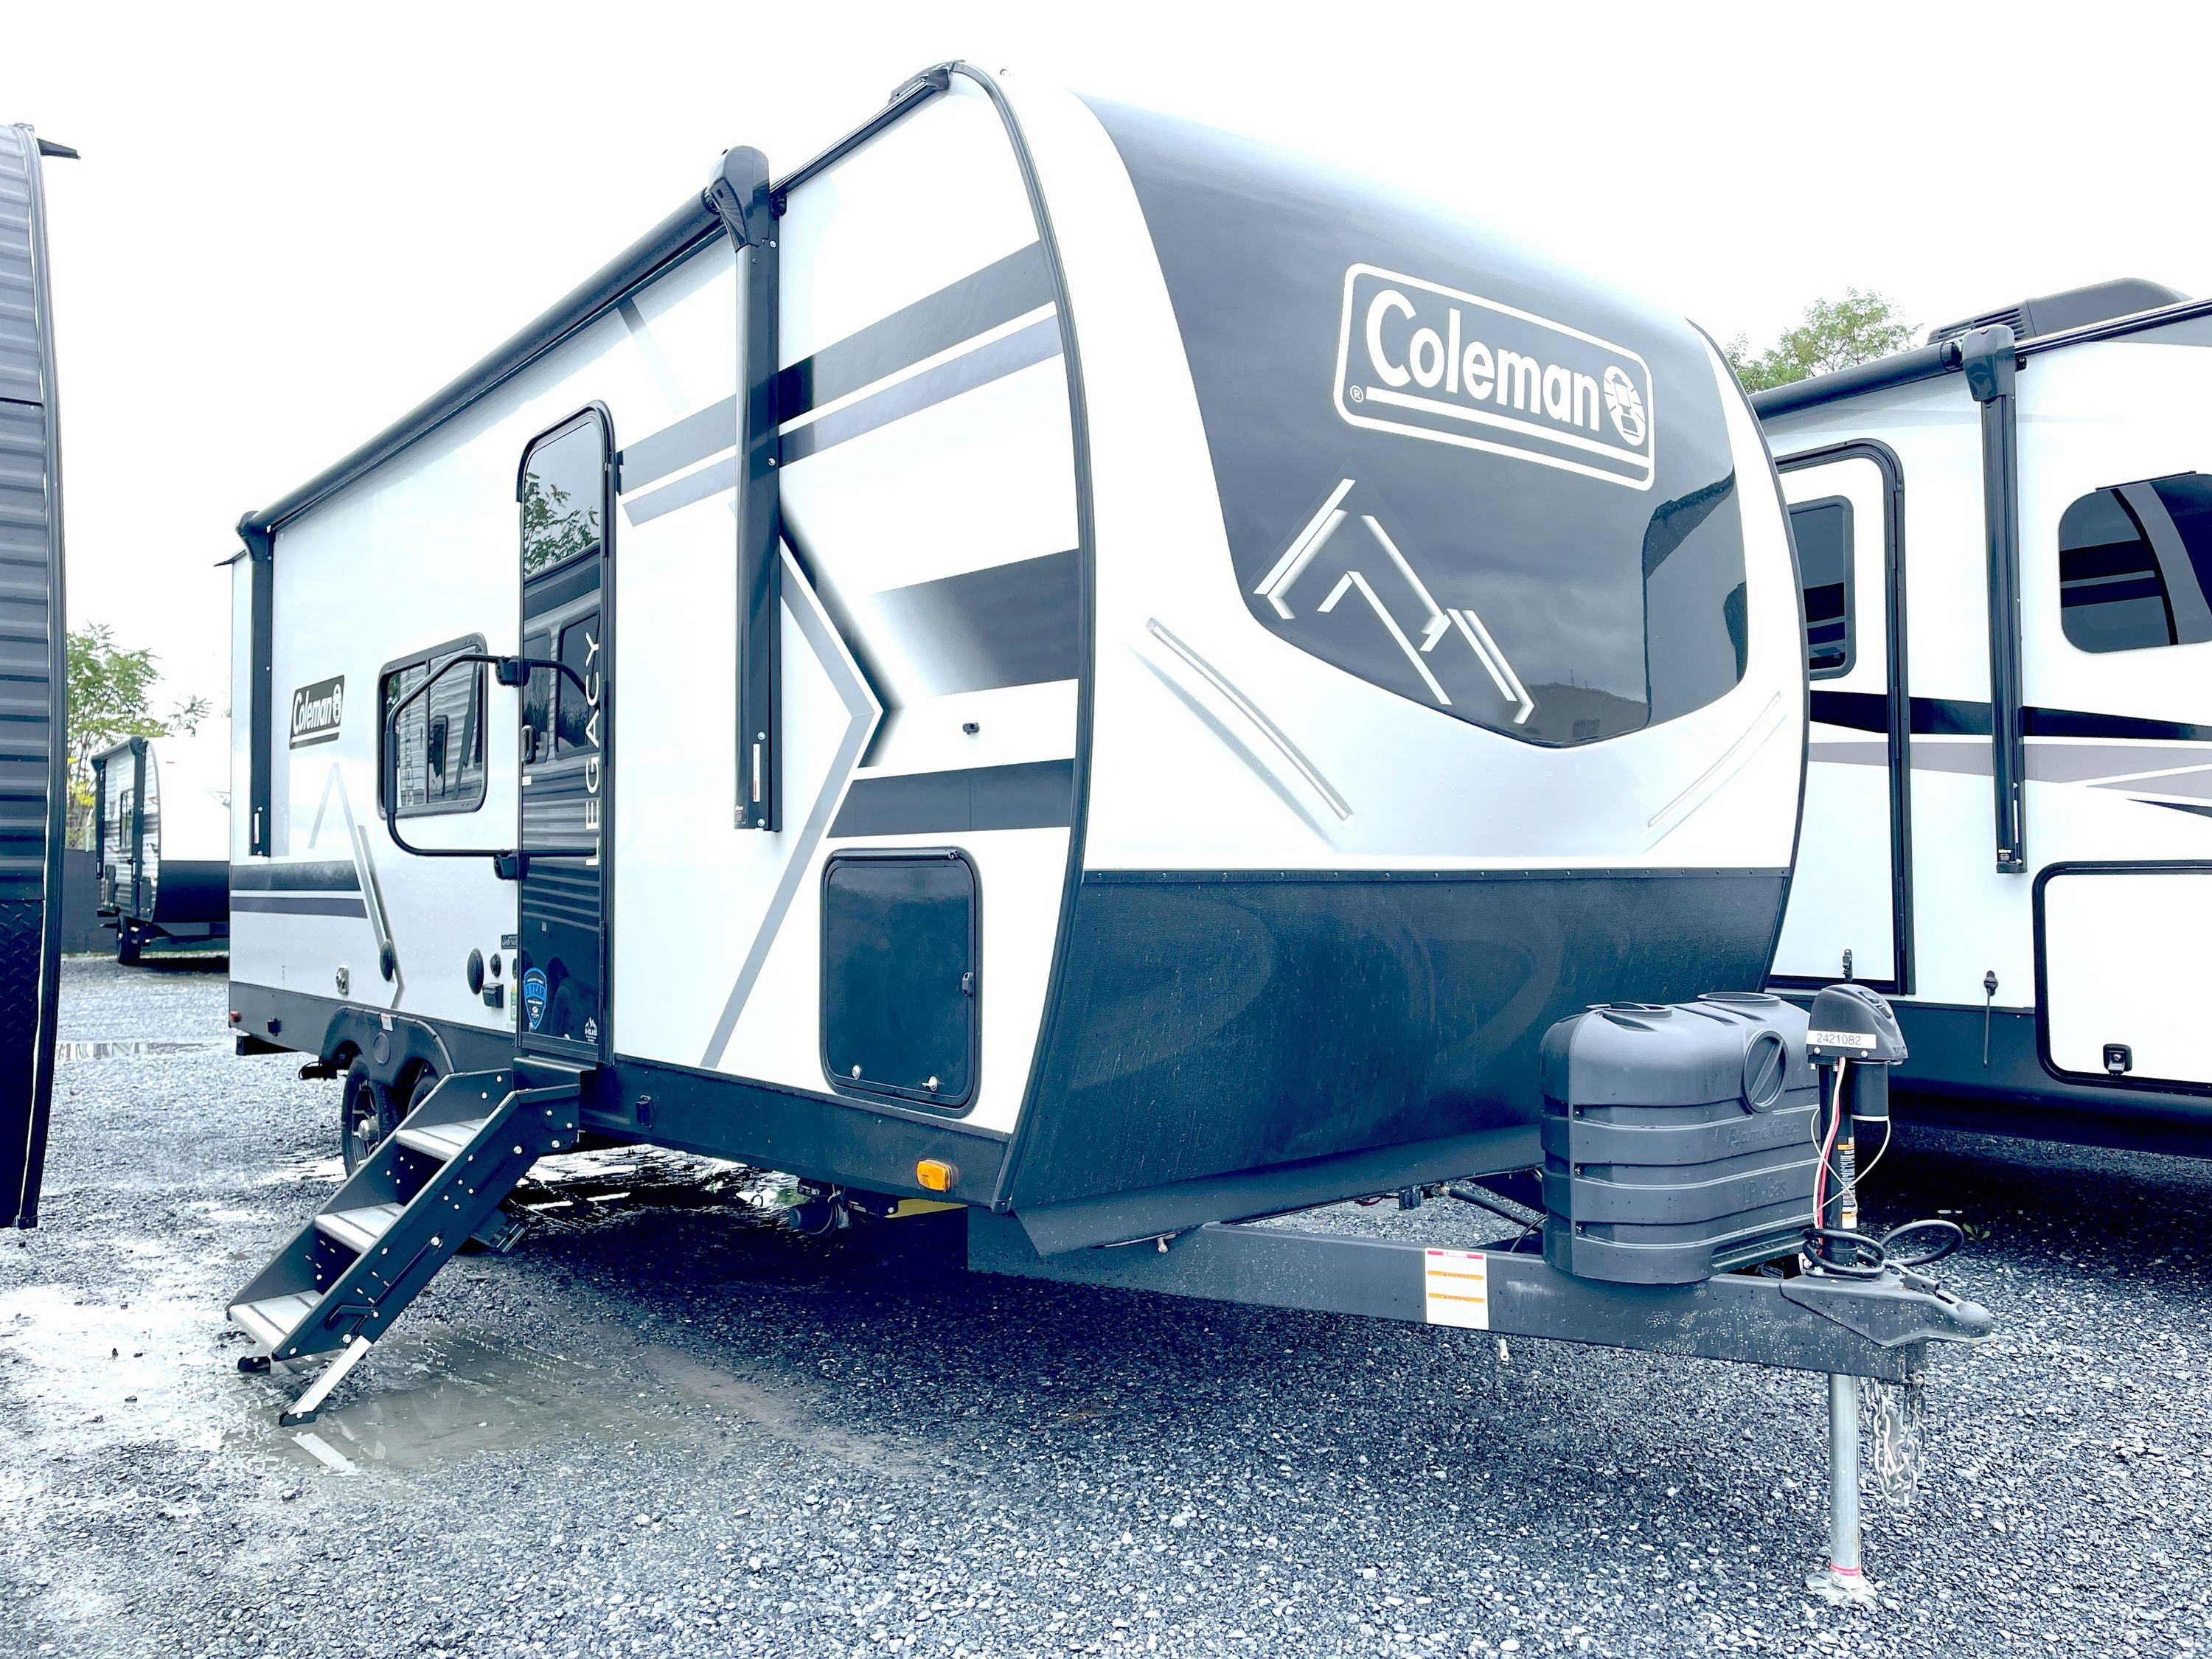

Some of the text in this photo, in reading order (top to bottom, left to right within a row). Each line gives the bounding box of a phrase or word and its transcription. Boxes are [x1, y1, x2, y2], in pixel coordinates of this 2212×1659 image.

[1366, 289, 1599, 431] Coleman
[293, 690, 333, 735] Coleman
[585, 632, 599, 866] LEGACY
[1816, 1033, 1862, 1046] 2421082
